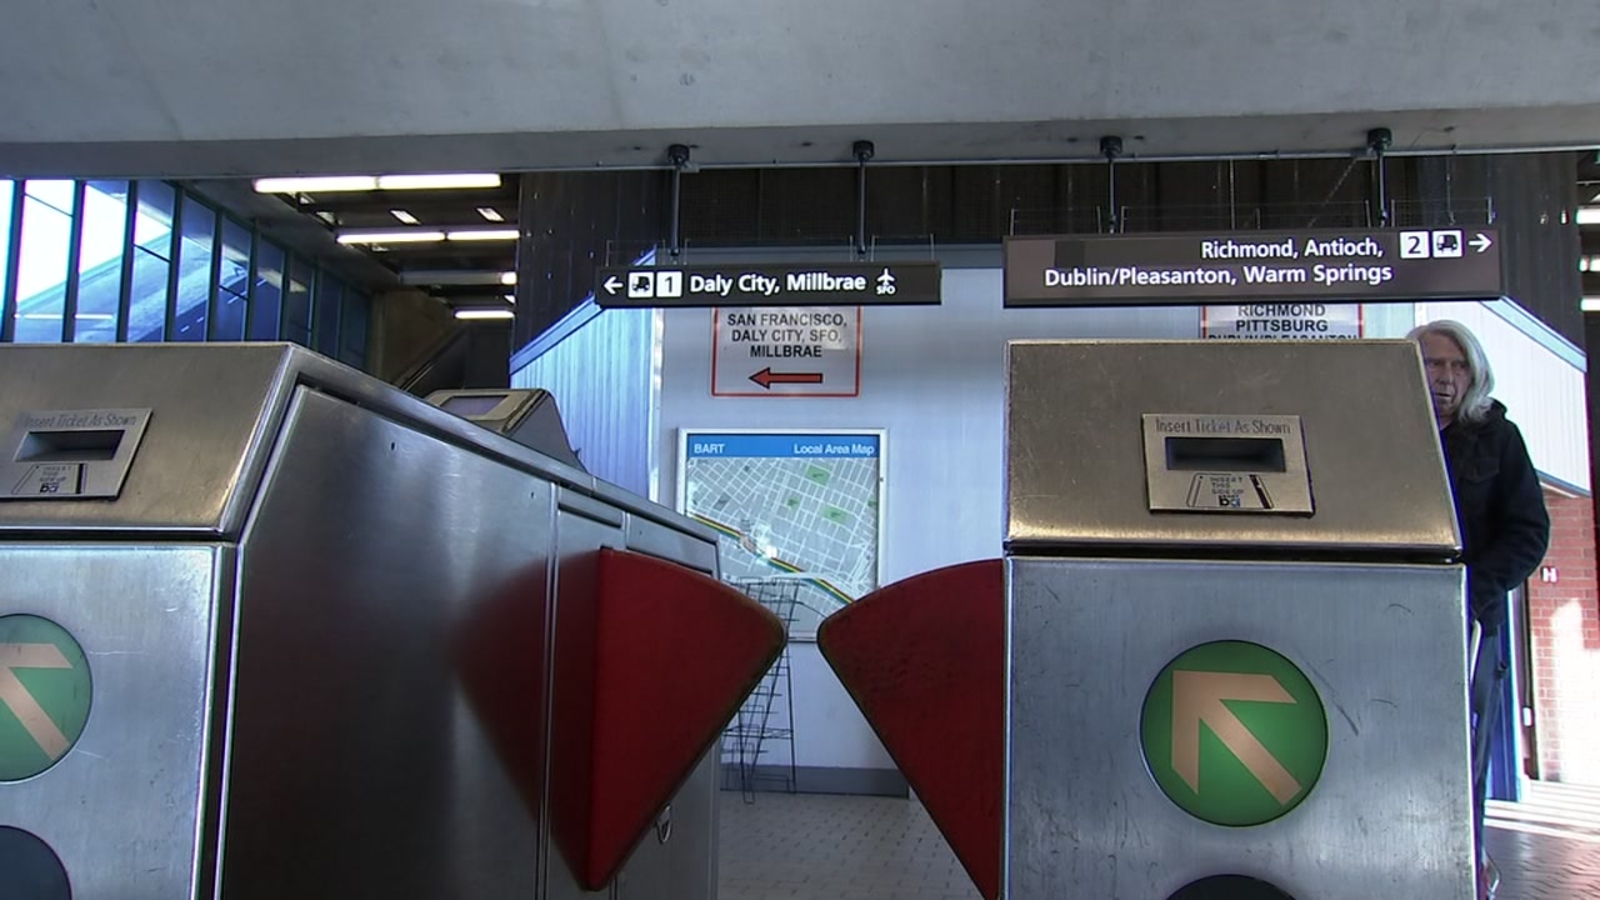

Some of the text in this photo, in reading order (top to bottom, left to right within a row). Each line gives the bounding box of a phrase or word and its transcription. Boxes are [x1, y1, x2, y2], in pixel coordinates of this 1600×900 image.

[1201, 238, 1384, 260] Richmond, Antioch,
[1045, 263, 1393, 286] Dublin/Pleasanton, Warm Springs
[690, 272, 866, 295] Daly City, Millbrae
[876, 285, 896, 295] SFO
[1237, 304, 1326, 317] RICHMOND
[727, 313, 847, 327] SAN FRANCISCO,
[1235, 319, 1328, 332] PITTSBURG
[731, 329, 767, 342] DALY
[771, 328, 805, 344] CITY,
[749, 345, 822, 358] MILLBRAE
[1155, 419, 1291, 435] Insert Ticket As Shown
[693, 443, 725, 455] BART
[794, 443, 875, 457] Local Area Map
